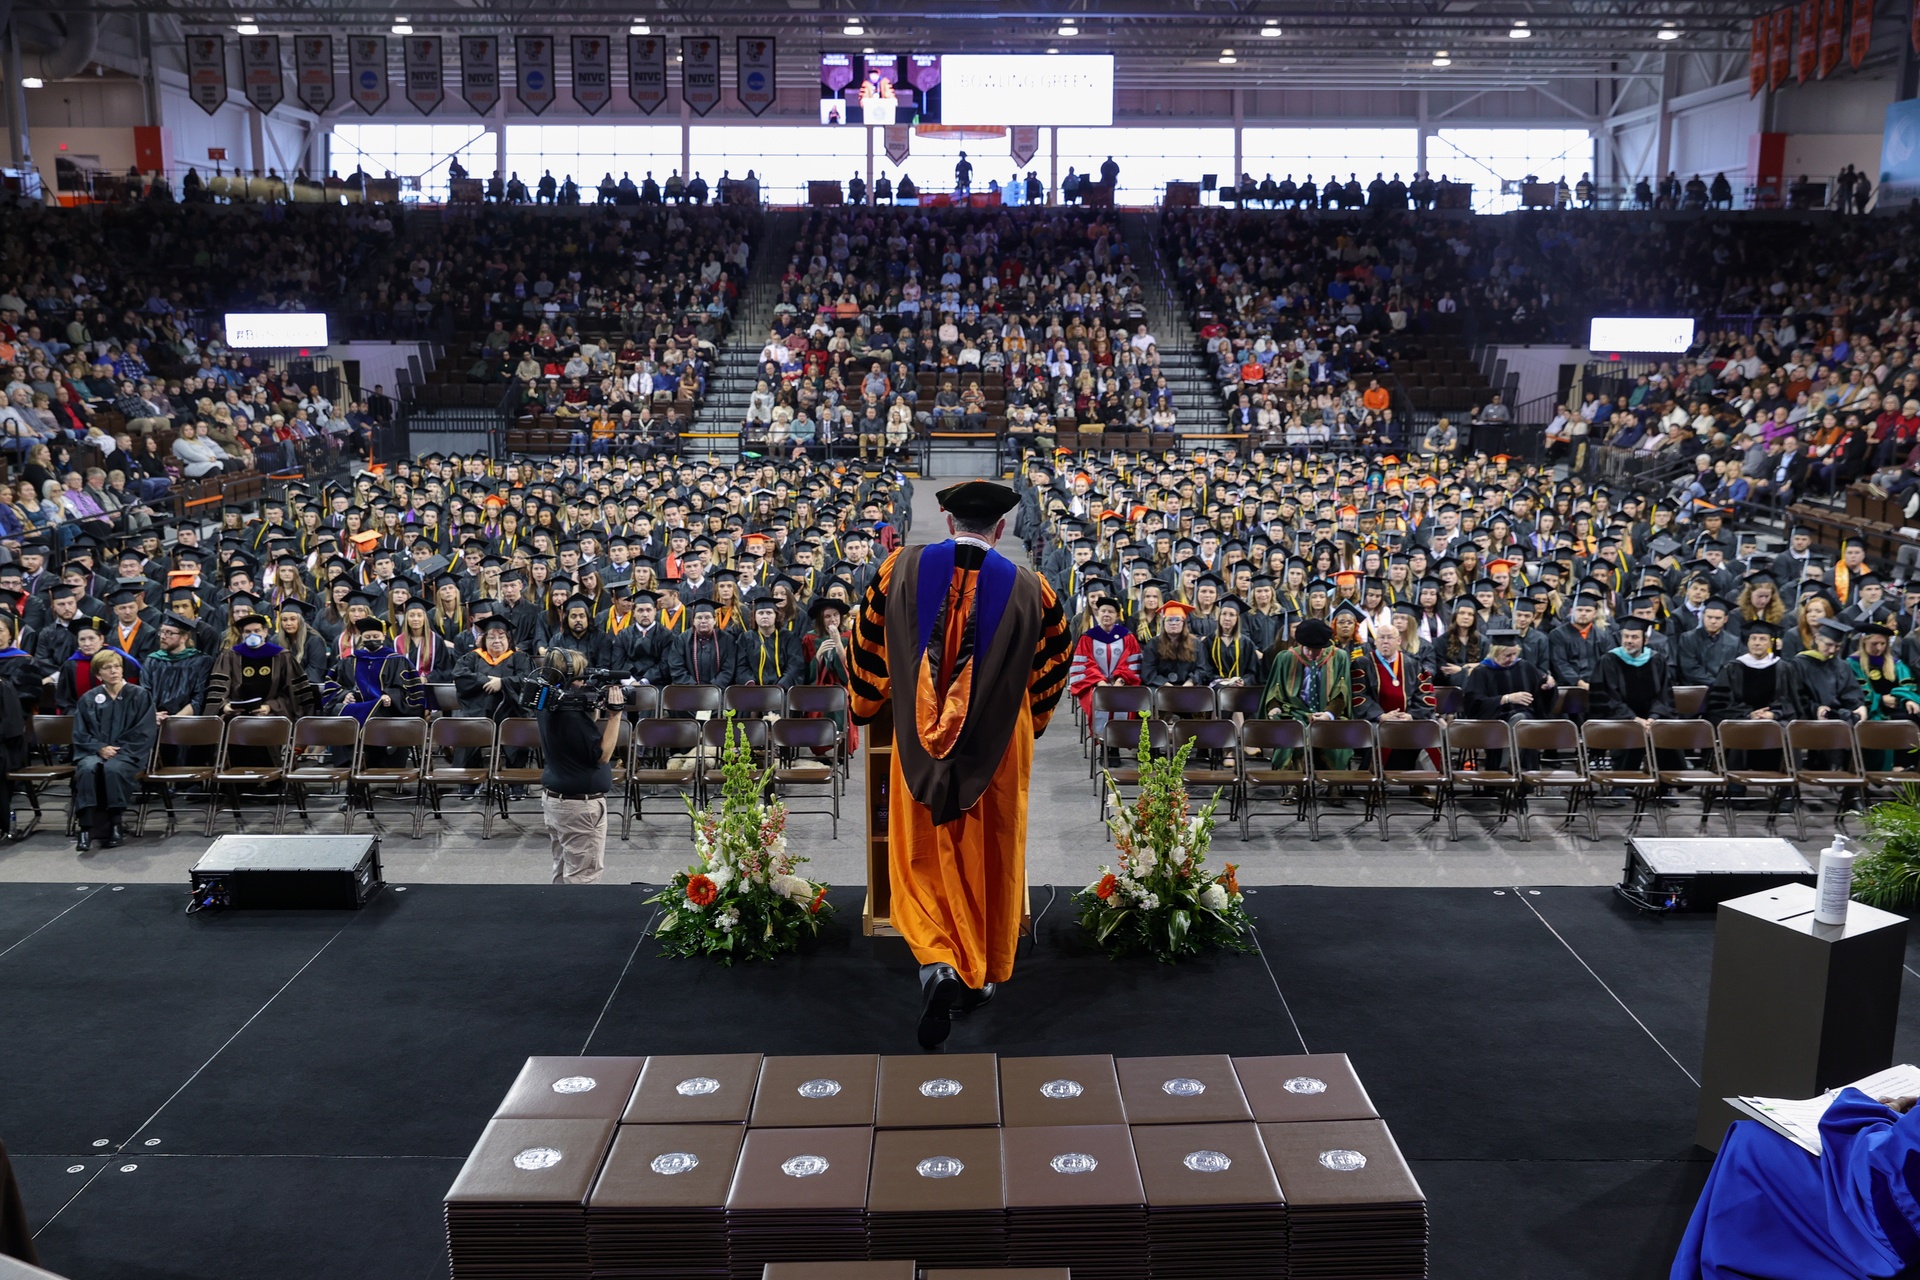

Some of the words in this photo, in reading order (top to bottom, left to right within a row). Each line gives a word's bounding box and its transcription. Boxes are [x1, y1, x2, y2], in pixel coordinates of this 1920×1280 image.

[411, 71, 438, 81] NIVC
[467, 73, 494, 83] NIVC
[578, 72, 605, 82] NIVC
[634, 72, 661, 82] NIVC
[688, 74, 715, 83] NIVC
